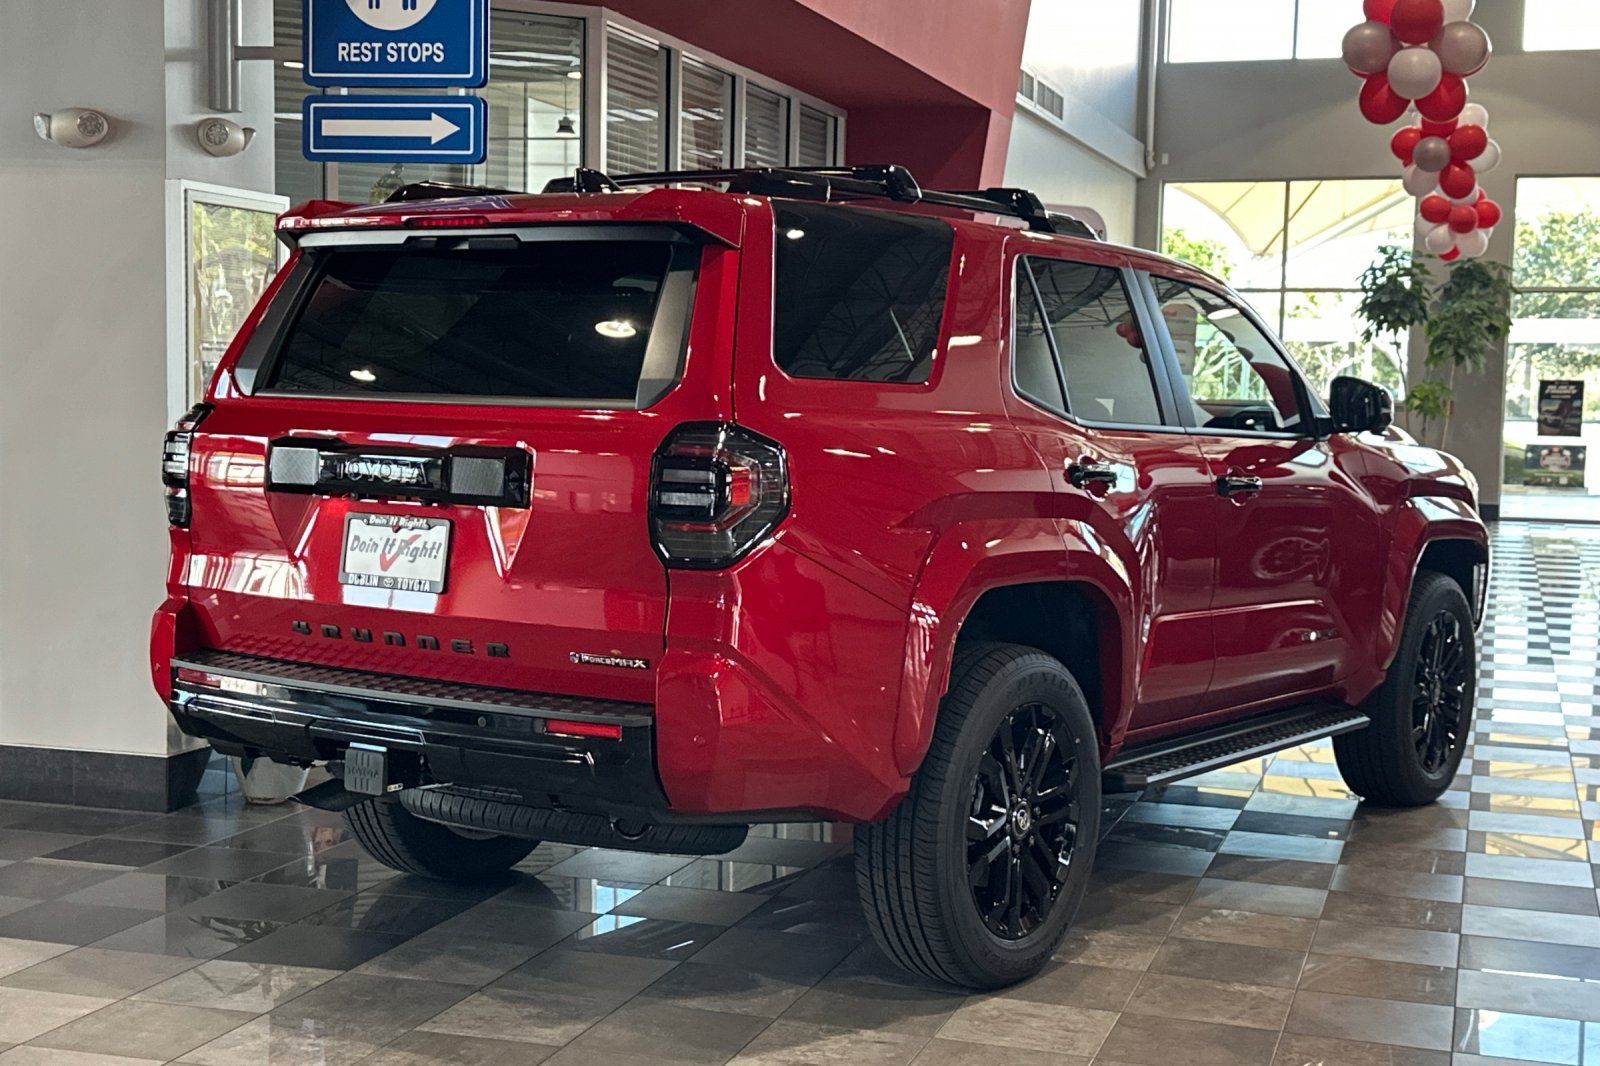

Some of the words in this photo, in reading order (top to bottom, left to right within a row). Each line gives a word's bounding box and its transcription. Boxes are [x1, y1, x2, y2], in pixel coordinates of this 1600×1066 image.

[337, 42, 383, 62] REST
[386, 42, 445, 63] STOPS
[334, 458, 428, 484] TOYOTA
[350, 535, 383, 553] Doin'
[382, 537, 397, 555] It
[399, 538, 442, 563] Right!
[348, 573, 379, 587] DUBLIN
[397, 578, 431, 592] TOYOTA
[291, 620, 511, 658] 4RUNNER
